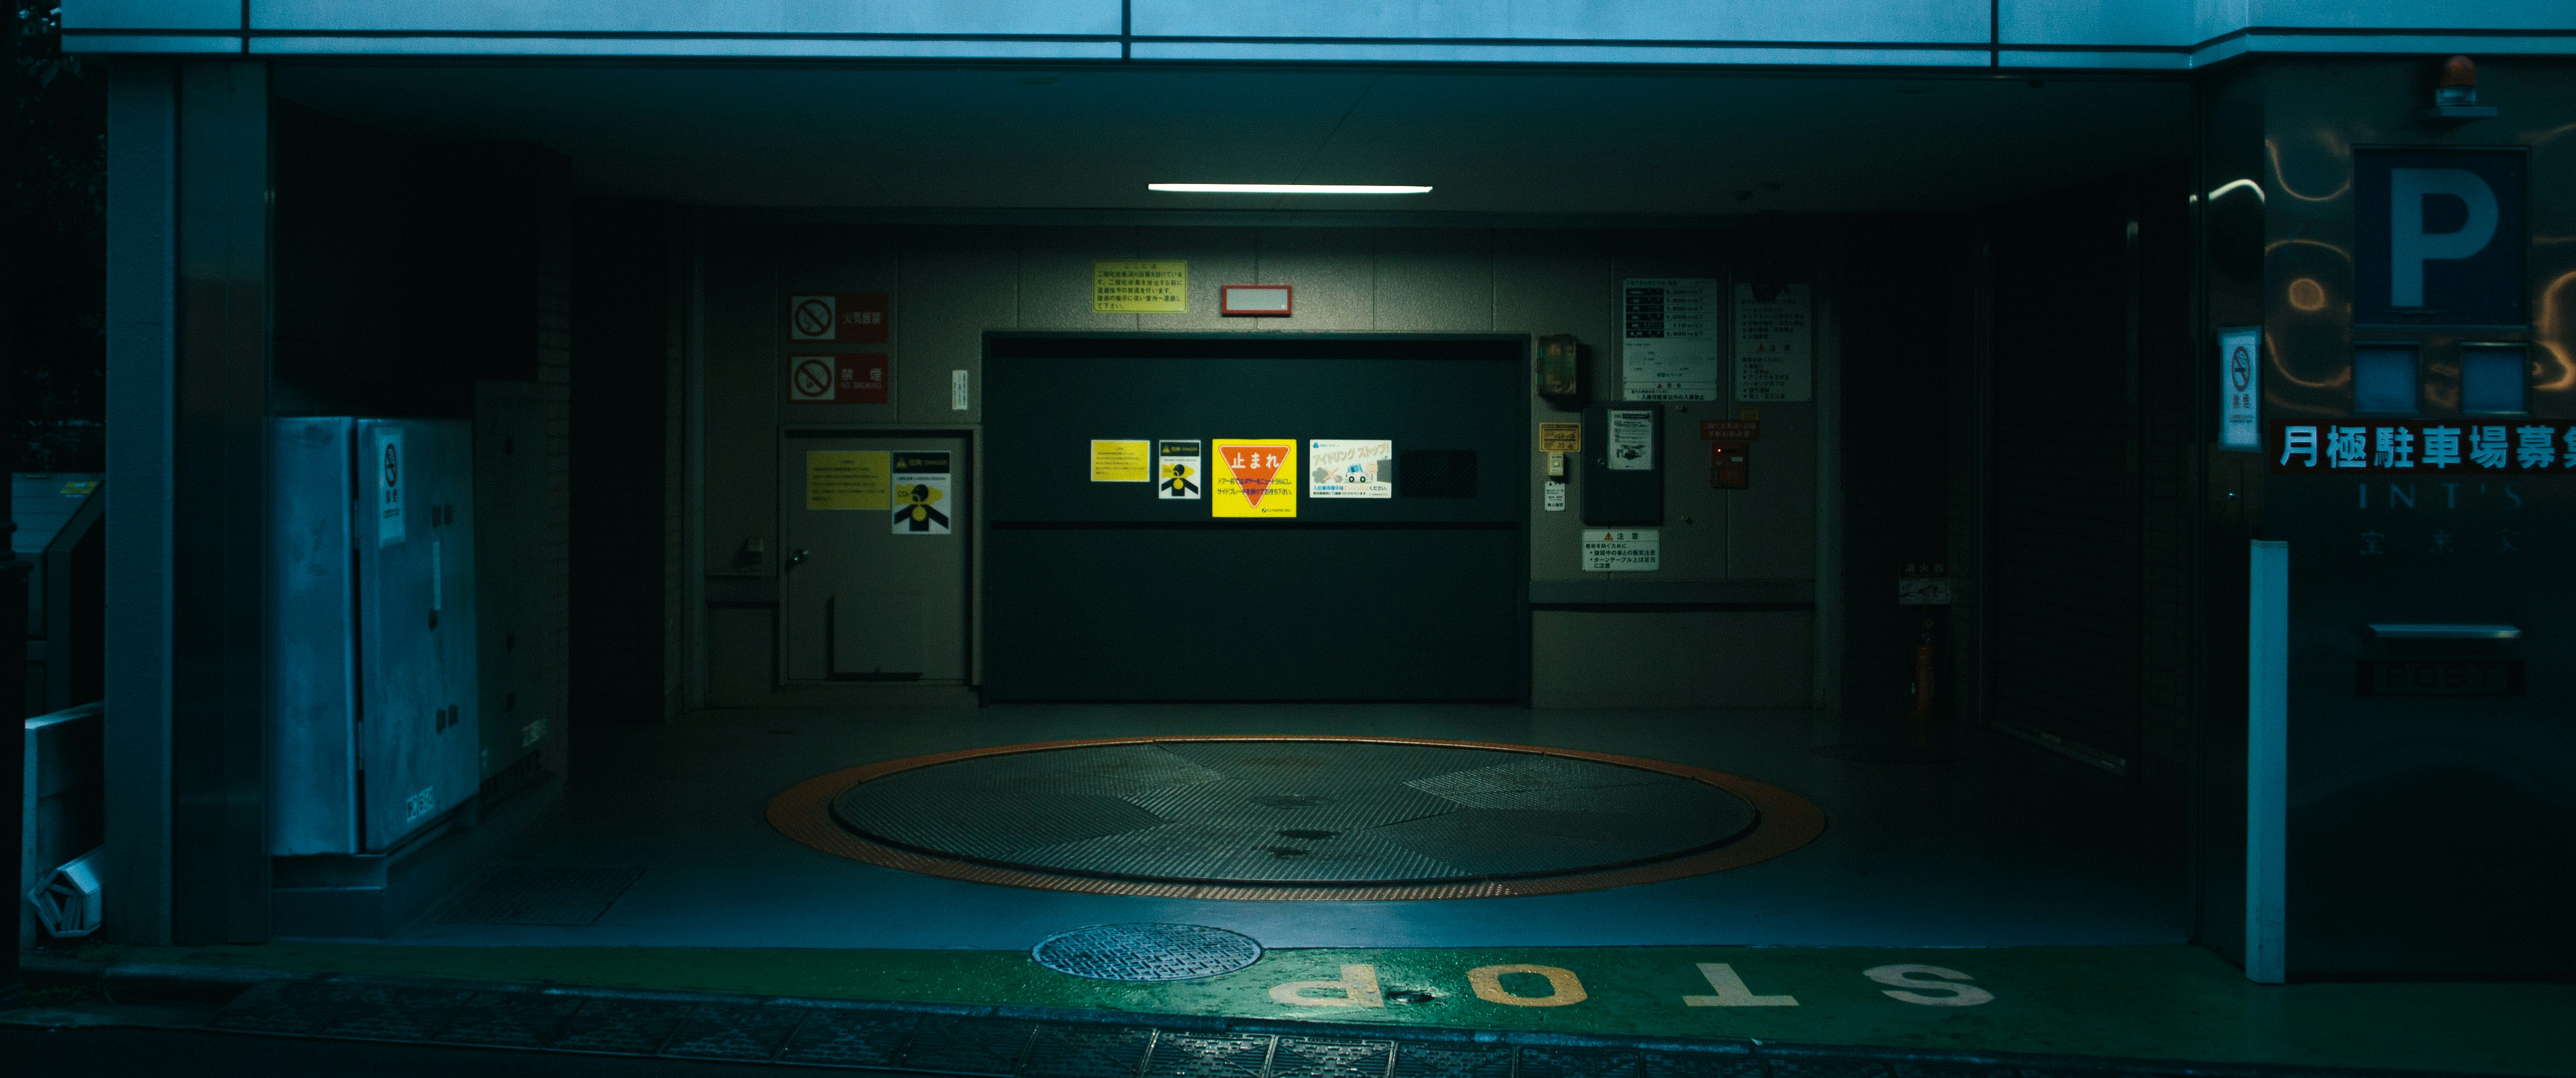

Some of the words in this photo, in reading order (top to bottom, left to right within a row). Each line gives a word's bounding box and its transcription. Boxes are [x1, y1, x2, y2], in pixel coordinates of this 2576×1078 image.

[2390, 168, 2500, 309] P
[1231, 452, 1280, 469] 止まれ
[2358, 482, 2523, 510] INT'S
[2385, 662, 2495, 689] POST
[1268, 961, 1996, 1009] STOP
